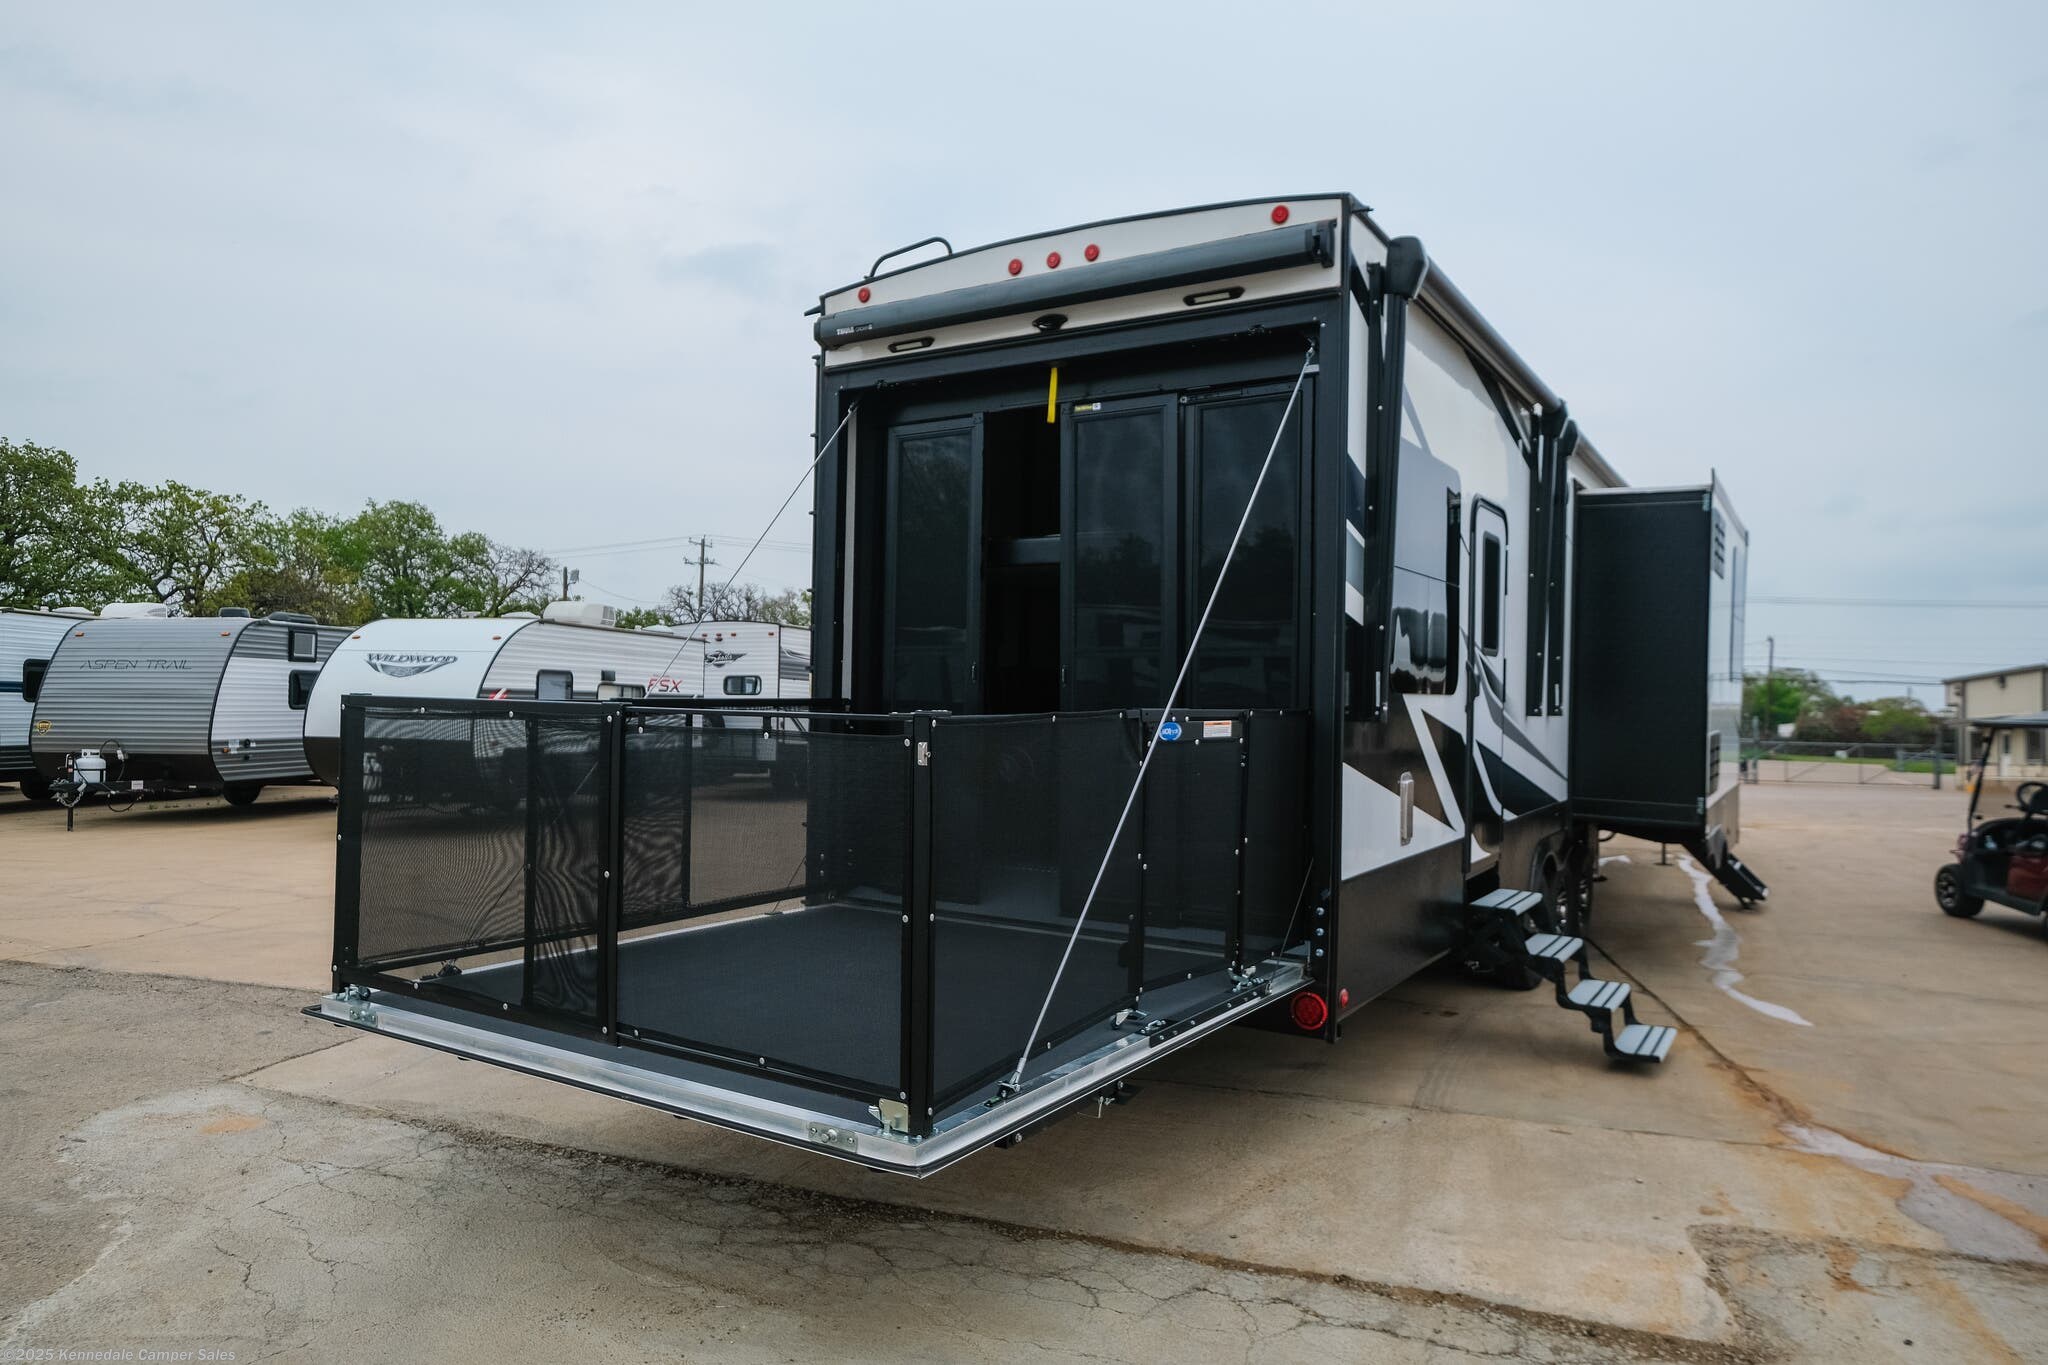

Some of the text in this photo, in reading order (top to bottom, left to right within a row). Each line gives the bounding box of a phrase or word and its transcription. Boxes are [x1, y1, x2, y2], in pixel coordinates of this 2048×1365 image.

[367, 653, 459, 664] WILDWOOD
[80, 659, 193, 670] ASPEN TRAIL
[647, 678, 683, 693] FSX
